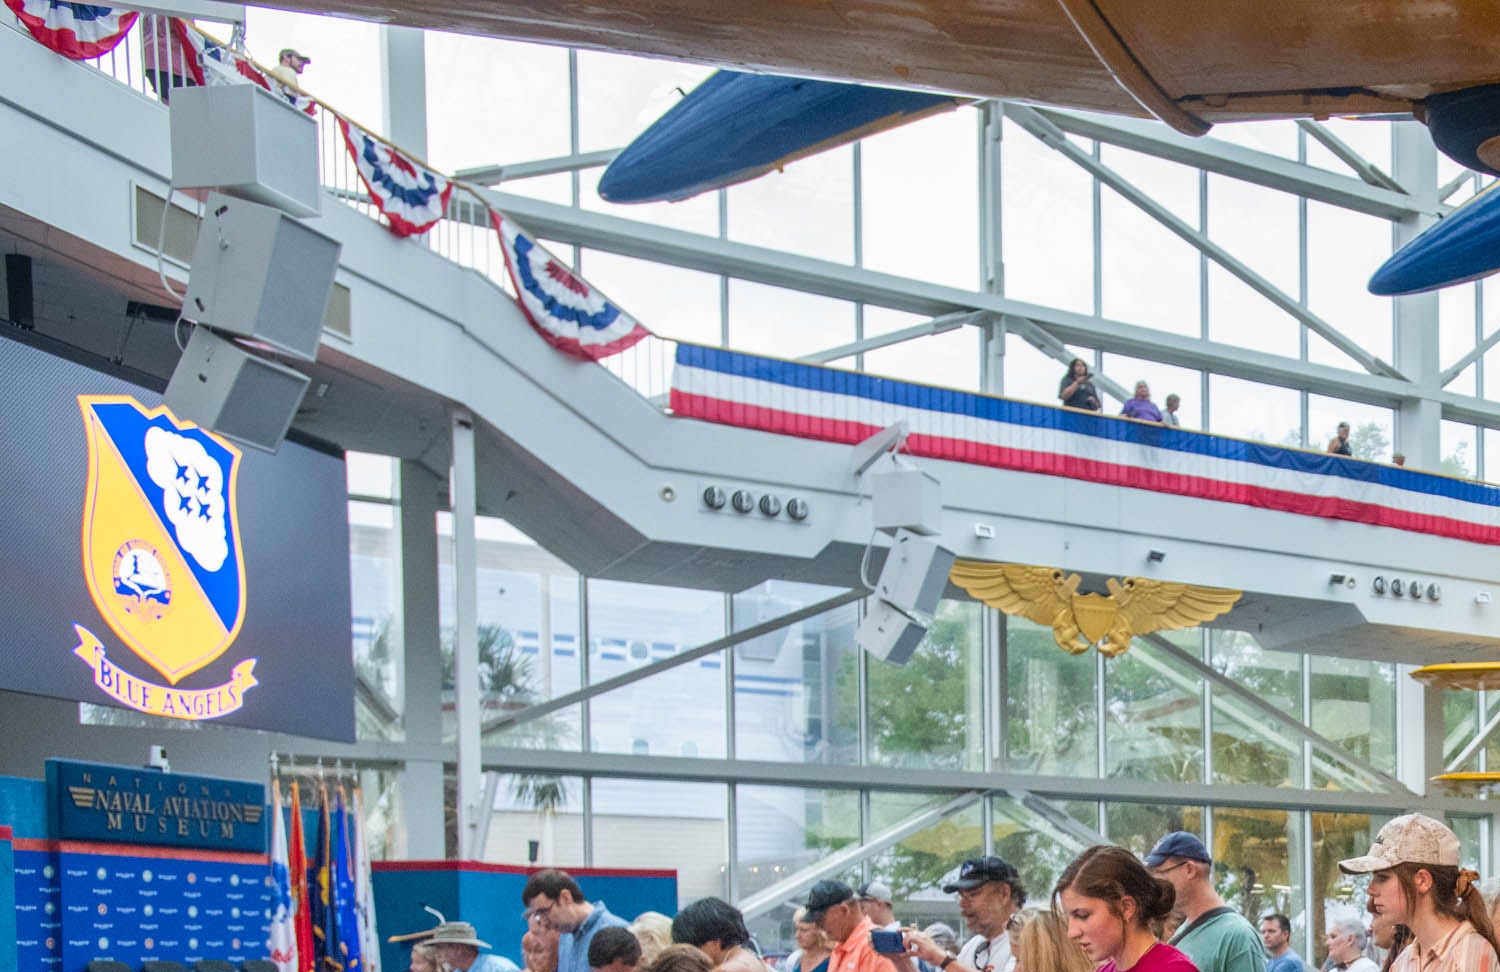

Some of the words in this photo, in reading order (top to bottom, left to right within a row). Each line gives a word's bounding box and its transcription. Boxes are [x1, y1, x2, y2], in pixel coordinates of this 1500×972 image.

[100, 659, 152, 708] BLUE
[162, 685, 239, 716] ANGELS
[96, 789, 155, 814] NAVAL
[162, 797, 244, 822] AVIATION
[107, 813, 235, 840] MUSEUM
